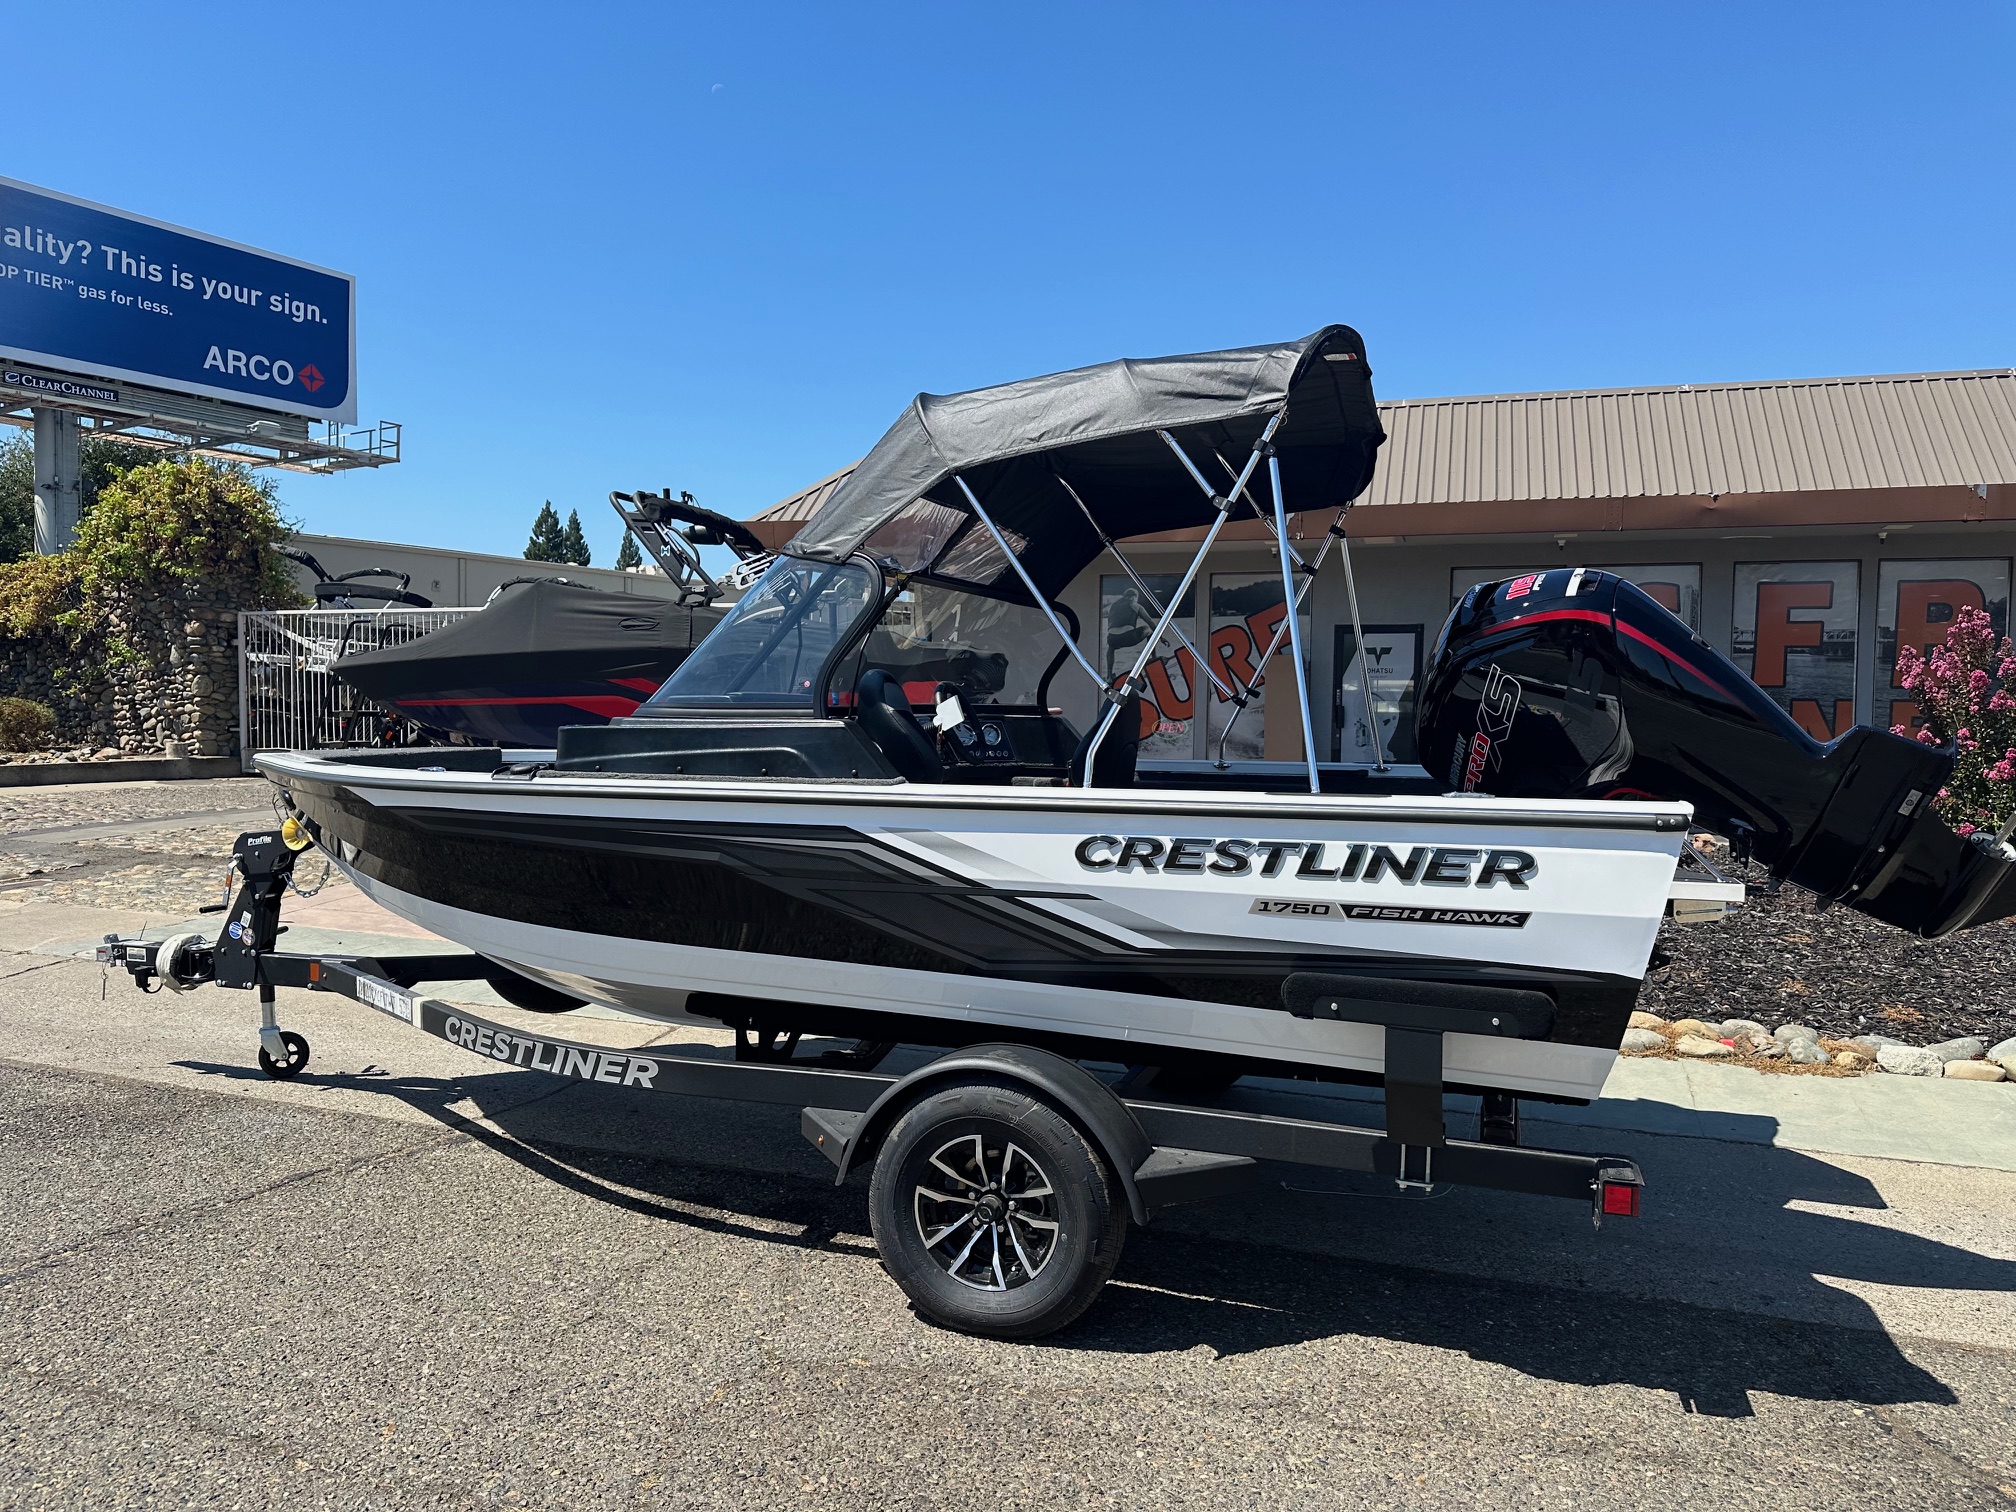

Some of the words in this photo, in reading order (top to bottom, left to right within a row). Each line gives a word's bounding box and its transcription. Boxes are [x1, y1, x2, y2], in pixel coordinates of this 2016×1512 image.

[0, 226, 92, 265] ality?
[101, 245, 163, 283] This
[172, 263, 195, 291] is
[201, 276, 263, 307] your
[269, 292, 328, 324] sign.
[78, 284, 107, 300] gas
[111, 289, 134, 306] for
[137, 296, 174, 316] less.
[203, 345, 294, 386] ARCO
[1153, 722, 1184, 734] OPEN
[1464, 732, 1490, 792] PRO
[1477, 663, 1521, 773] XS
[1450, 733, 1467, 787] MERCURY
[247, 836, 272, 846] Profile
[1074, 835, 1539, 890] CRESTLINER
[1258, 900, 1330, 915] 1750
[1350, 907, 1424, 920] FISH
[1431, 911, 1526, 925] HAWK
[445, 1016, 659, 1088] CRESTLINER
